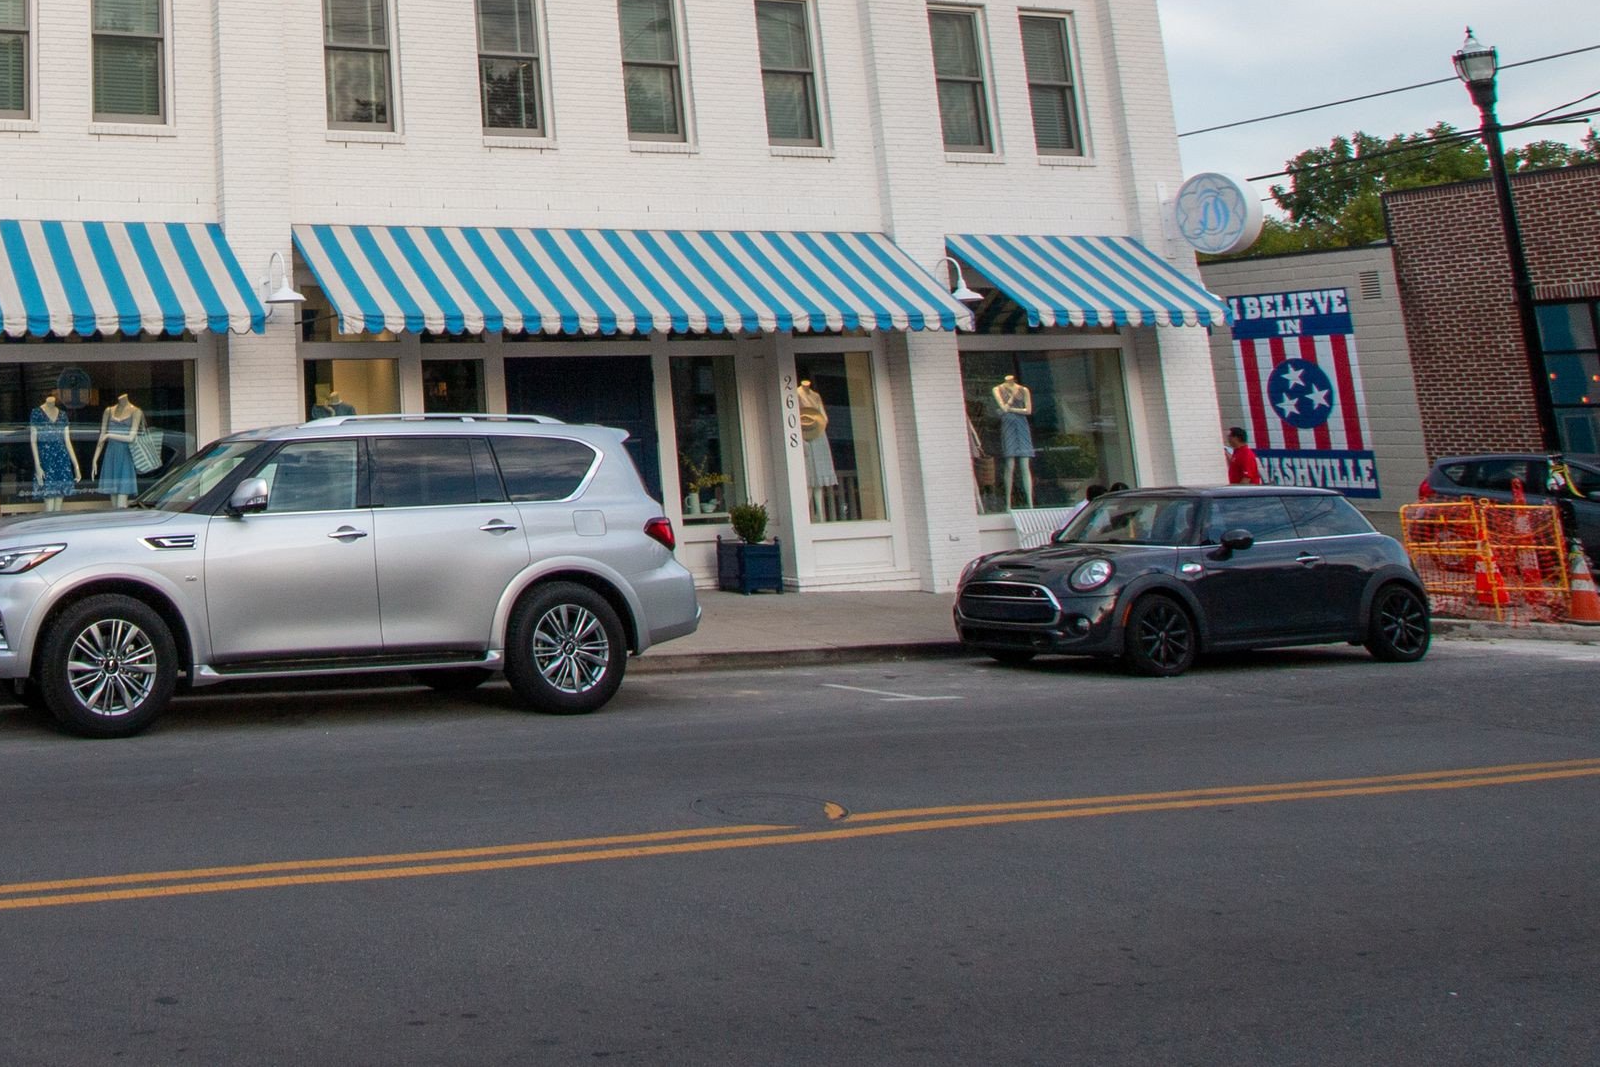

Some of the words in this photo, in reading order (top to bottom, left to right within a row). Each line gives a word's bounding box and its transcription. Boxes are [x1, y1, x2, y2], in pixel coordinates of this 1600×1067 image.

[1229, 297, 1240, 321] I
[1243, 289, 1347, 320] BELIEVE
[1276, 319, 1301, 335] IN
[783, 375, 798, 448] 2608
[1256, 457, 1377, 489] NASHVILLE
